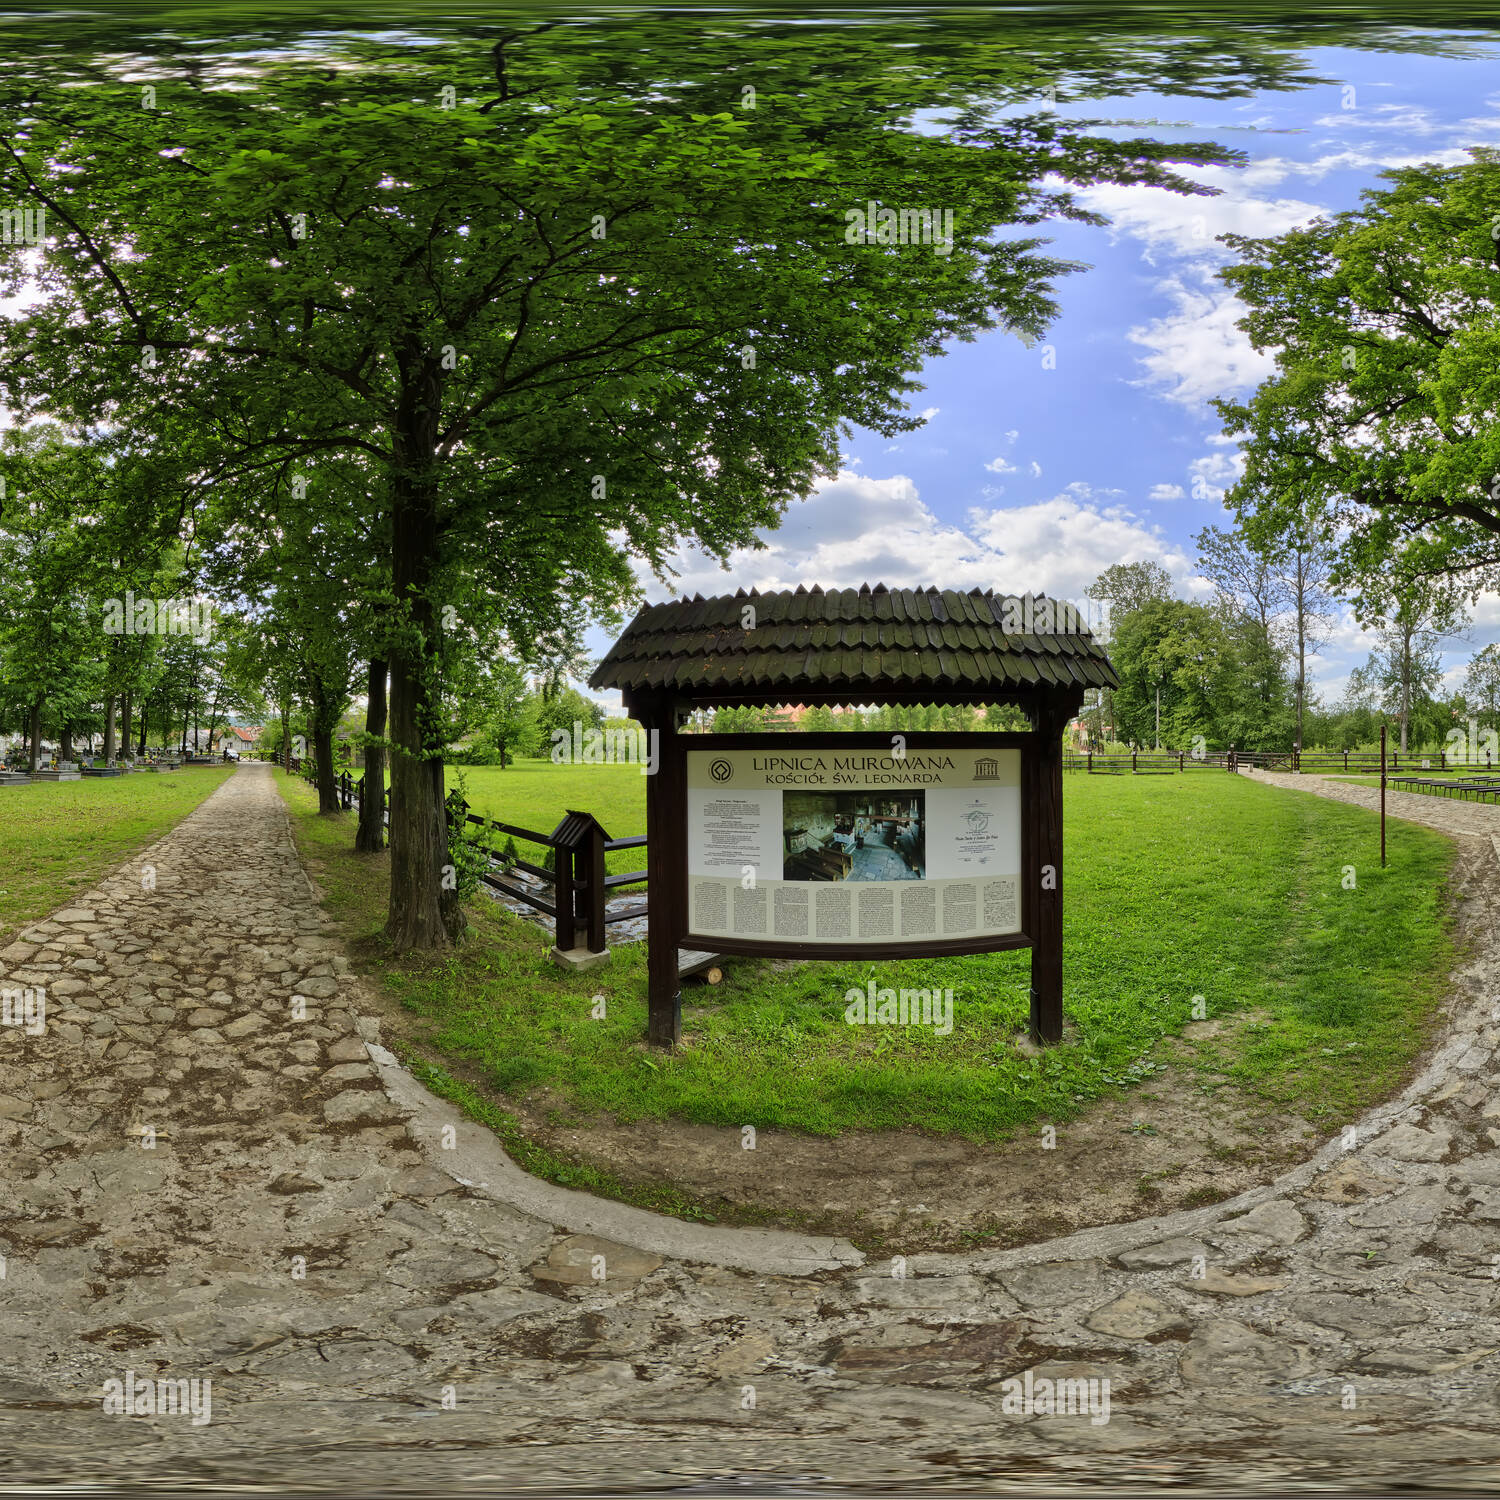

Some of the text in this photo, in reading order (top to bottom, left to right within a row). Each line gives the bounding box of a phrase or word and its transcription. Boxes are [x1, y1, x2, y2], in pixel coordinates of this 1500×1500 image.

[753, 756, 955, 771] LIPNICA MUROWANA
[765, 772, 942, 784] KOŚCIÓŁ ŚW. LEONARDA
